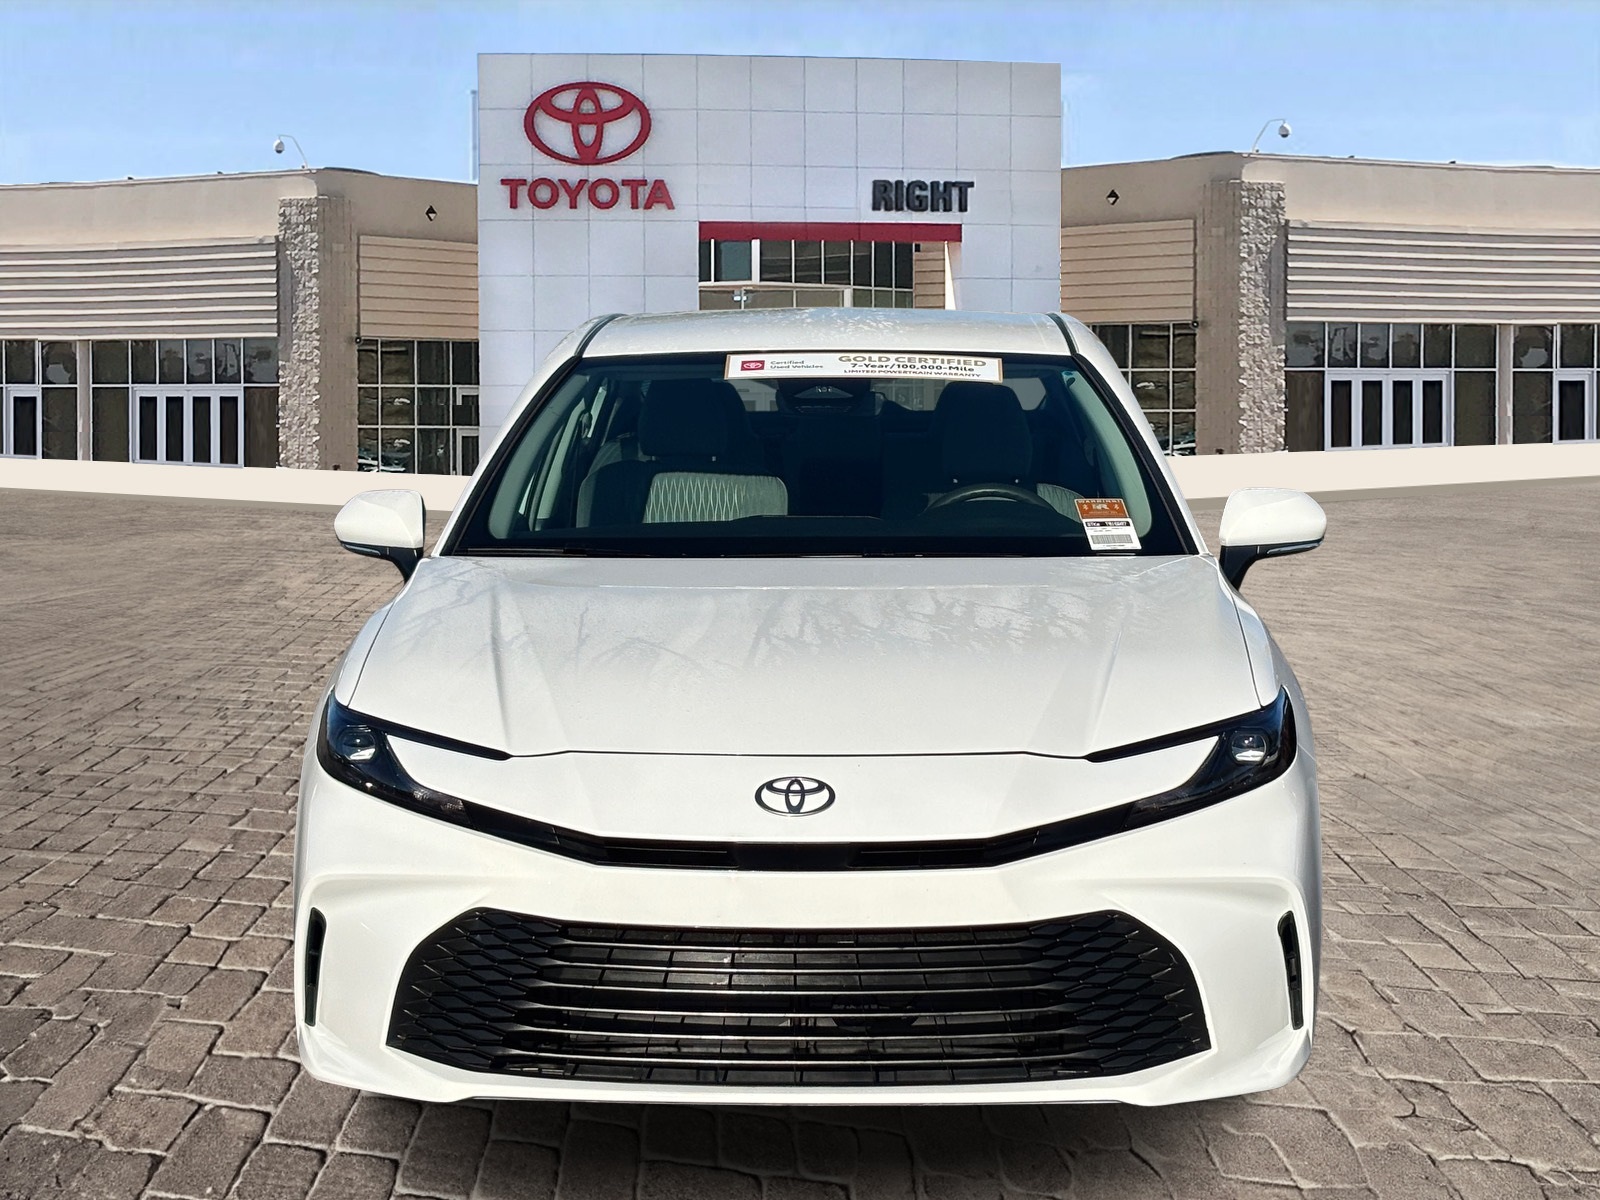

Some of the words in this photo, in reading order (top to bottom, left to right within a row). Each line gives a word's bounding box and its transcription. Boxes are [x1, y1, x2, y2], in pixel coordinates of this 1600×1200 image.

[500, 178, 675, 209] TOYOTA
[871, 179, 975, 212] RIGHT
[838, 355, 891, 363] GOLD
[894, 356, 987, 367] CERTIFIED
[850, 362, 975, 372] 7-Year/100,000-Mile
